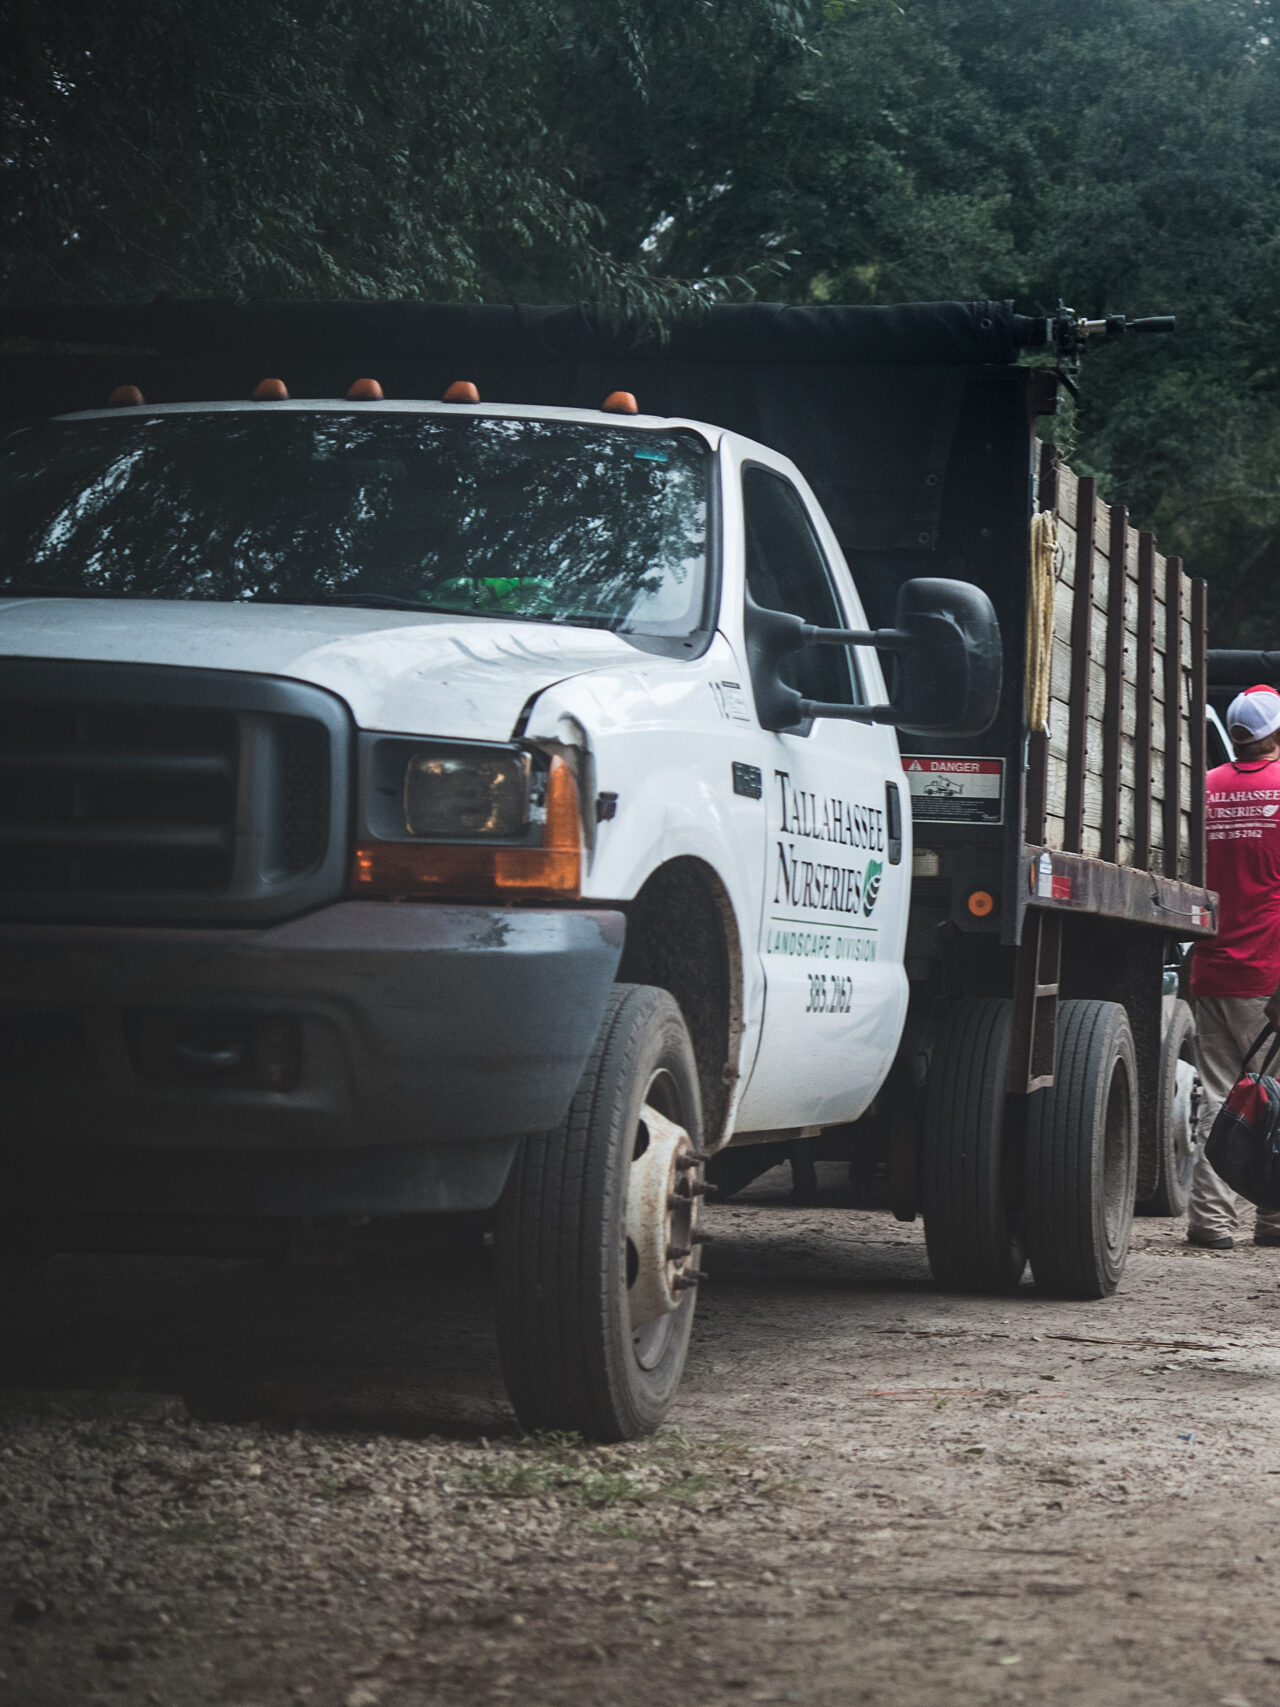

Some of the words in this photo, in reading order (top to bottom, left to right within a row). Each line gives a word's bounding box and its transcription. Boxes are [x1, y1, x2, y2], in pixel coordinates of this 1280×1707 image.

[930, 761, 980, 773] DANGER
[774, 769, 884, 852] TALLAHASSEE
[1205, 805, 1263, 819] URSERIES
[773, 841, 862, 914] NURSERIES
[766, 929, 831, 959] LANDSCAPE
[835, 936, 876, 962] DIVISION
[806, 973, 853, 1013] 385.2162
